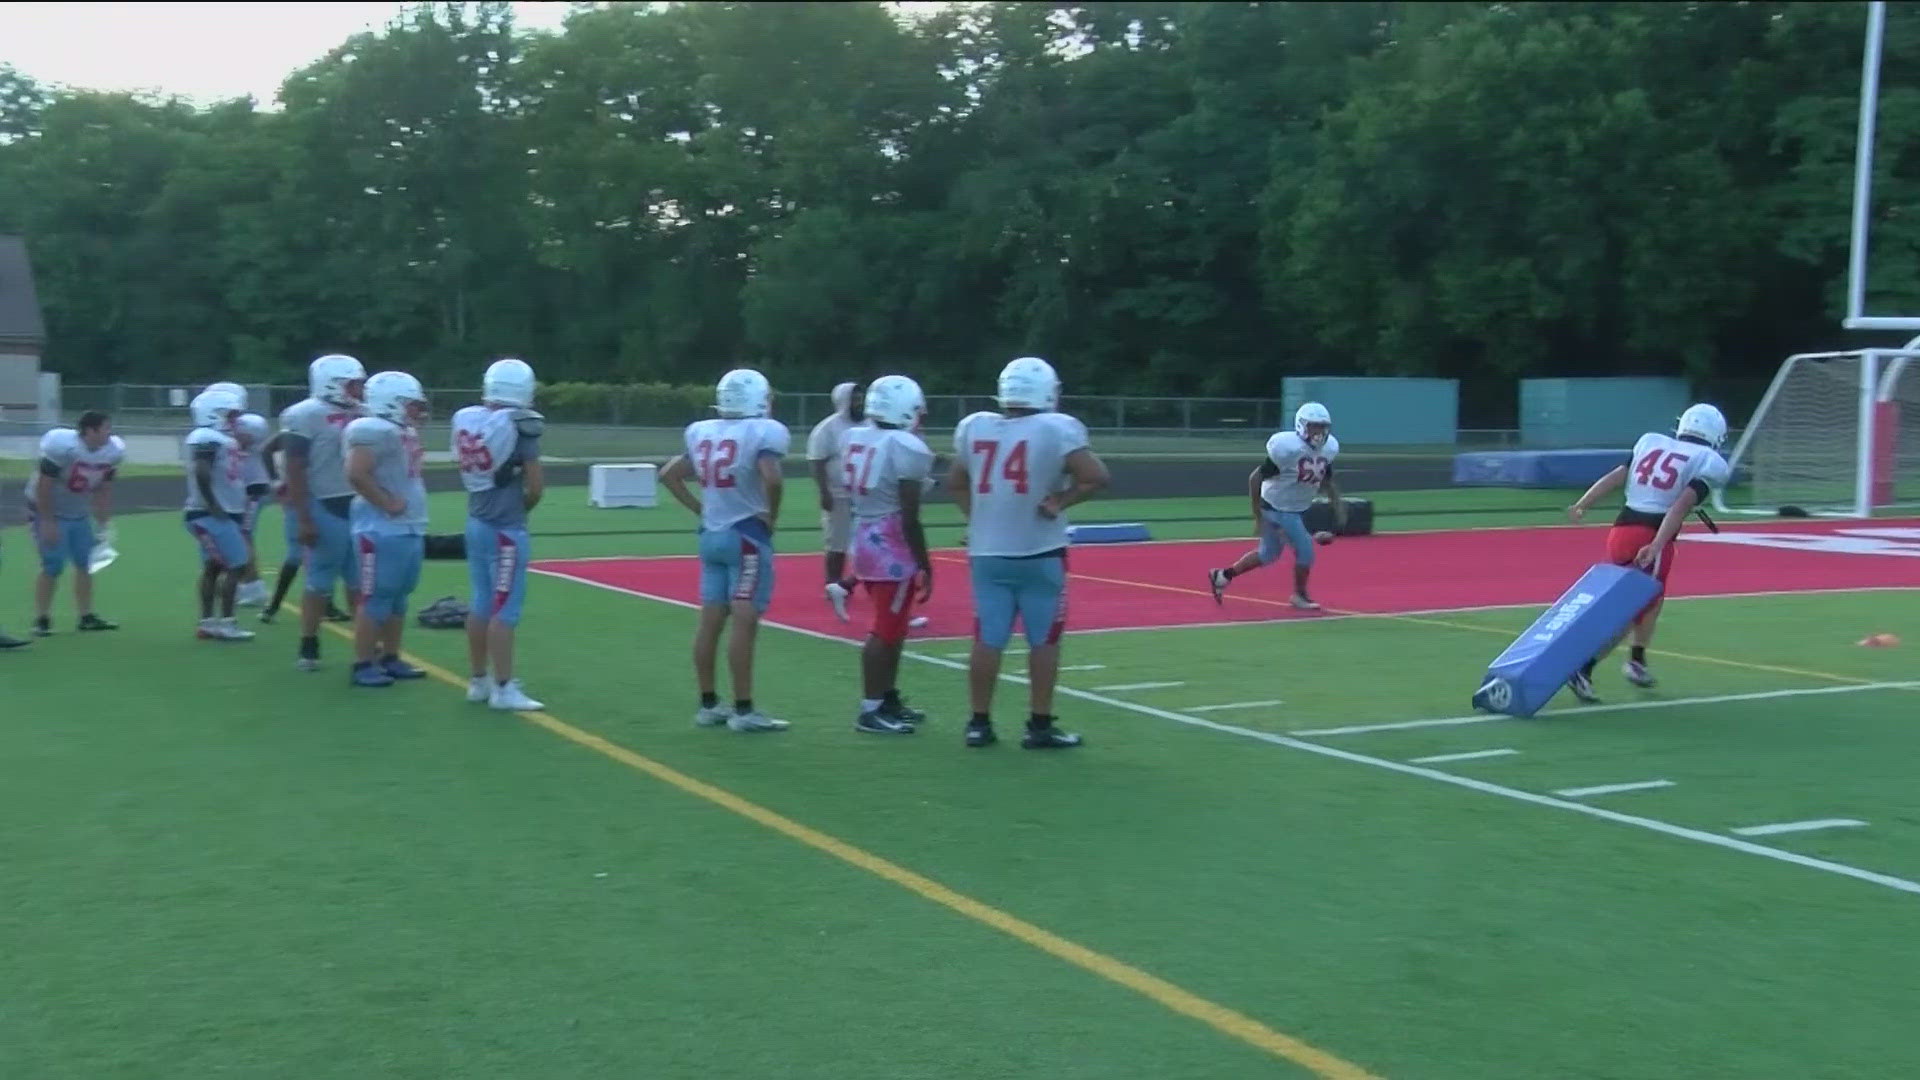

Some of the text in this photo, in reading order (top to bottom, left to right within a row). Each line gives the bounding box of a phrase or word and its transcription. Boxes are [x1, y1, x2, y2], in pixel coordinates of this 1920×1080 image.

[843, 443, 877, 496] 51
[973, 440, 1029, 494] 74
[1634, 448, 1690, 490] 45
